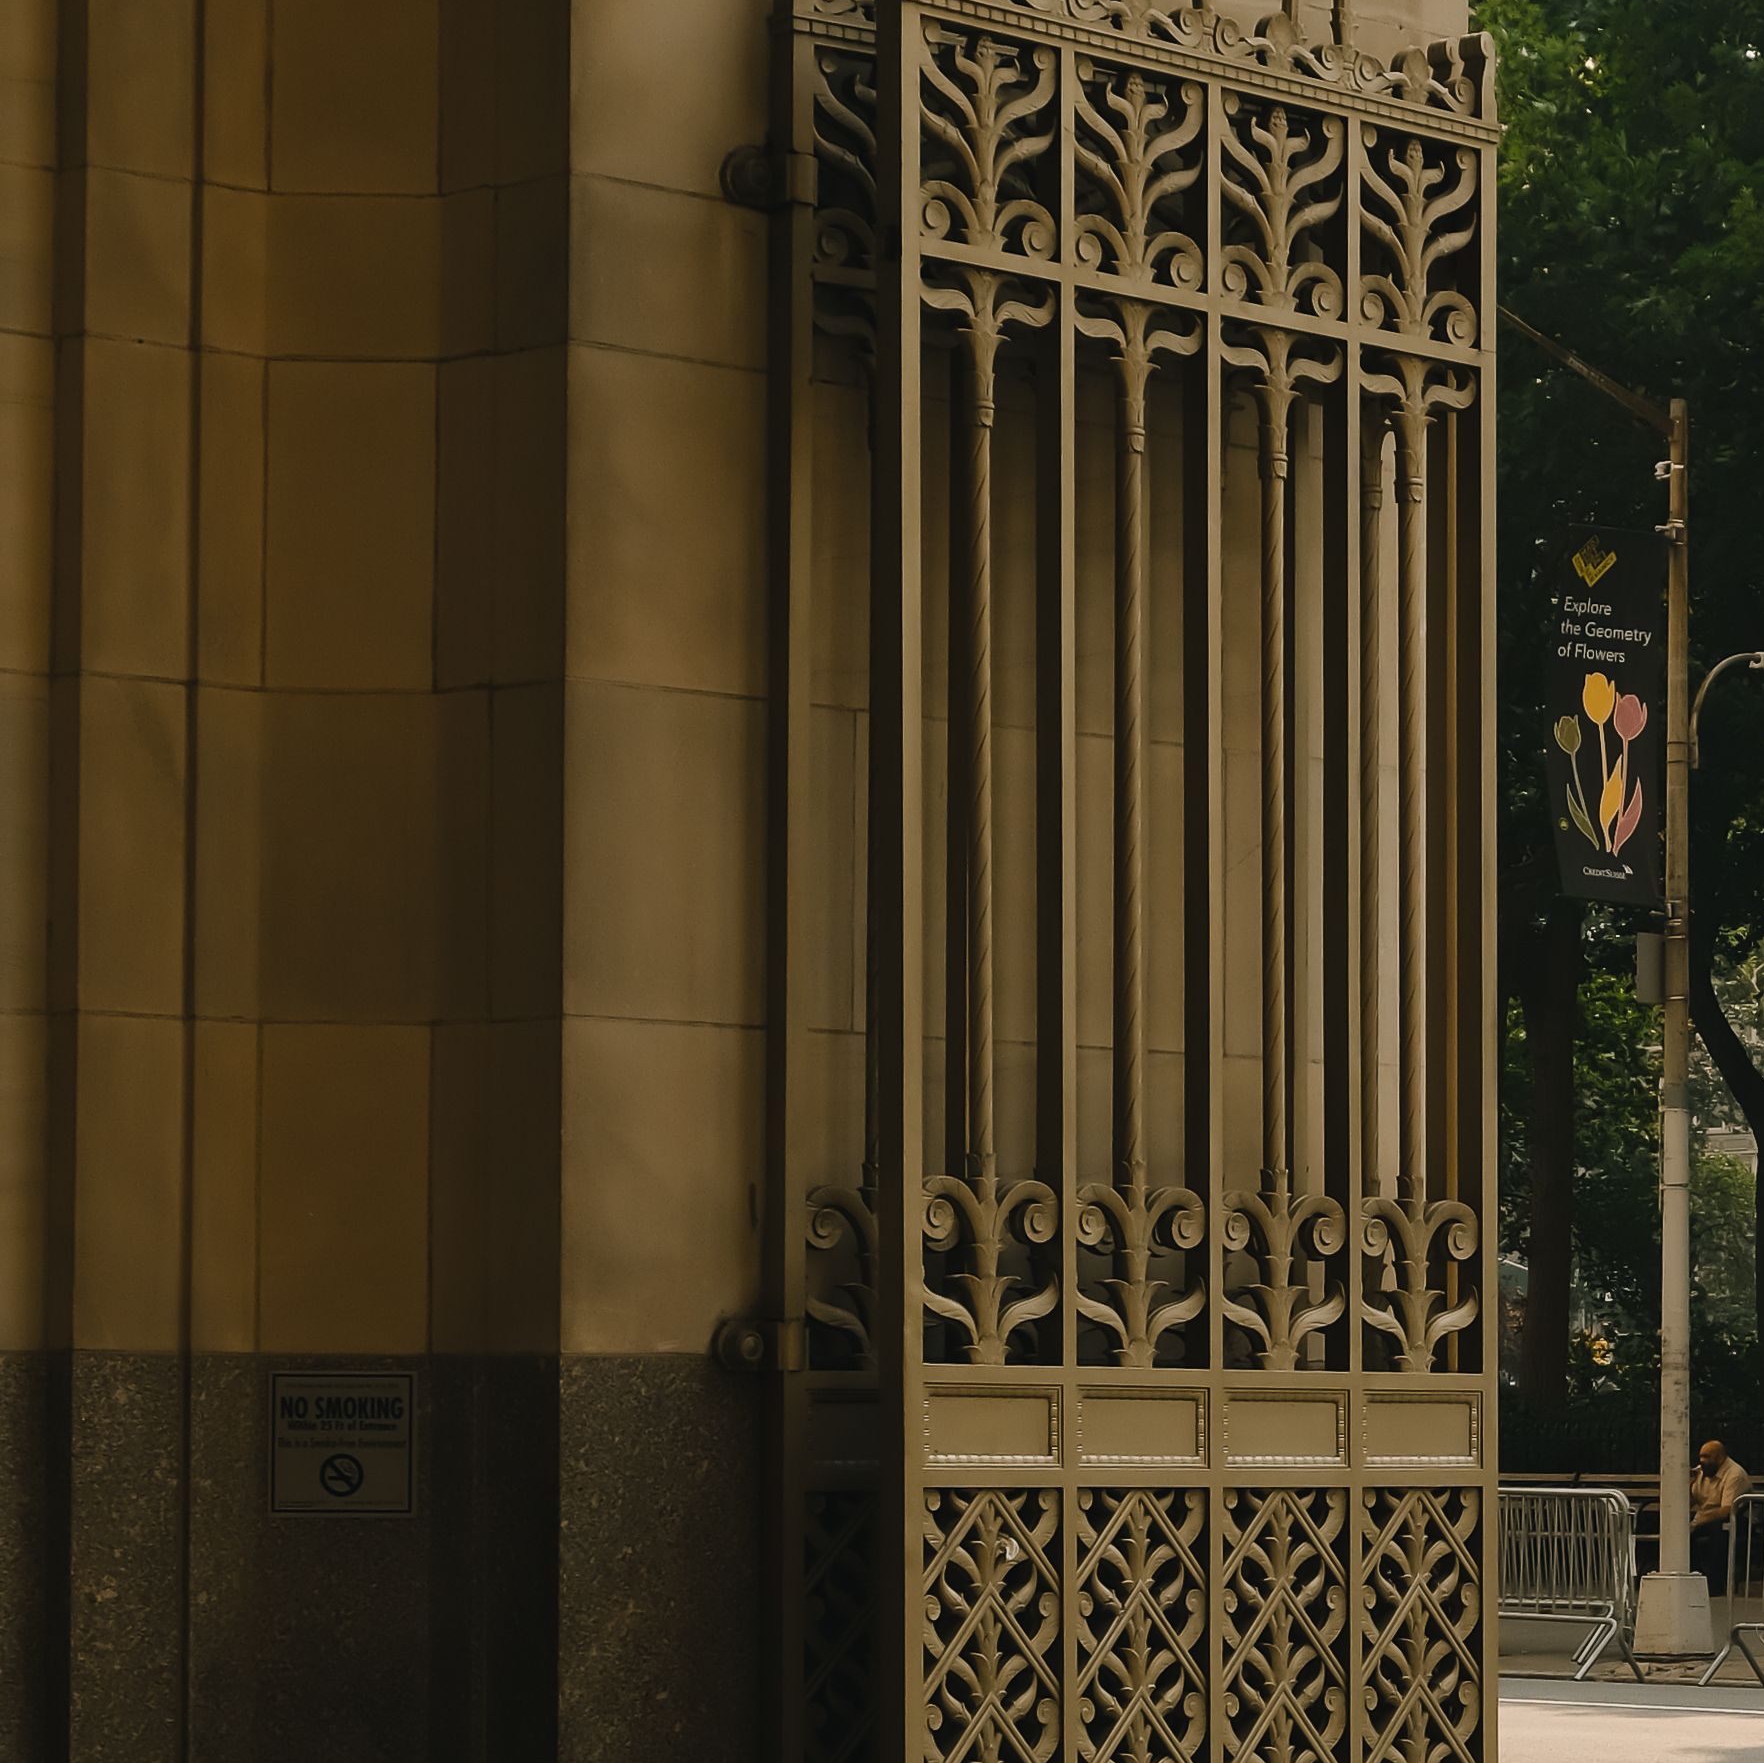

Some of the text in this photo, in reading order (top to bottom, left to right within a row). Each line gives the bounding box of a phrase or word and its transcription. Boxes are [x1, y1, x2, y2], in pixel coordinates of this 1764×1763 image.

[1563, 596, 1612, 617] Explore
[1561, 618, 1651, 646] the Geometry
[1557, 641, 1626, 663] of Flowers
[280, 1396, 404, 1419] NO SMOKING
